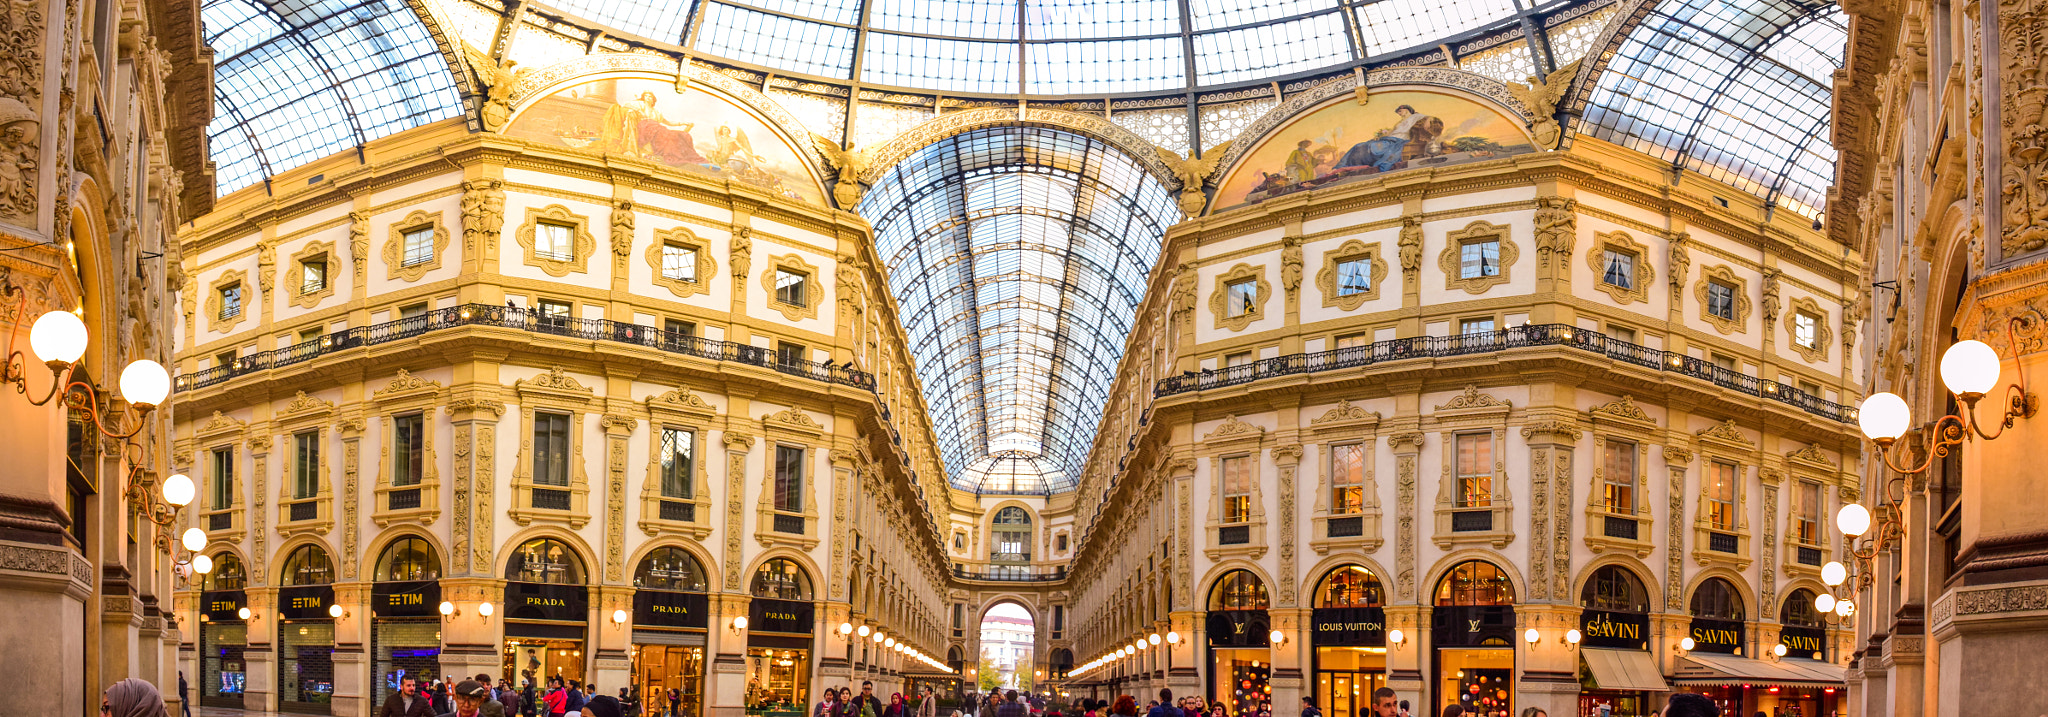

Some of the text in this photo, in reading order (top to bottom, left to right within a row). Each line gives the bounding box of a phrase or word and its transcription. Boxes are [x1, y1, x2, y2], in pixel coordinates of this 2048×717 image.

[527, 597, 565, 607] PRADA
[653, 605, 688, 614] PRADA
[765, 612, 797, 621] PRADA
[1319, 622, 1382, 632] LOUIS VUITTON
[1587, 620, 1640, 639] SAVINI
[1693, 627, 1738, 646] SAVINI
[1782, 635, 1821, 651] SAVINI
